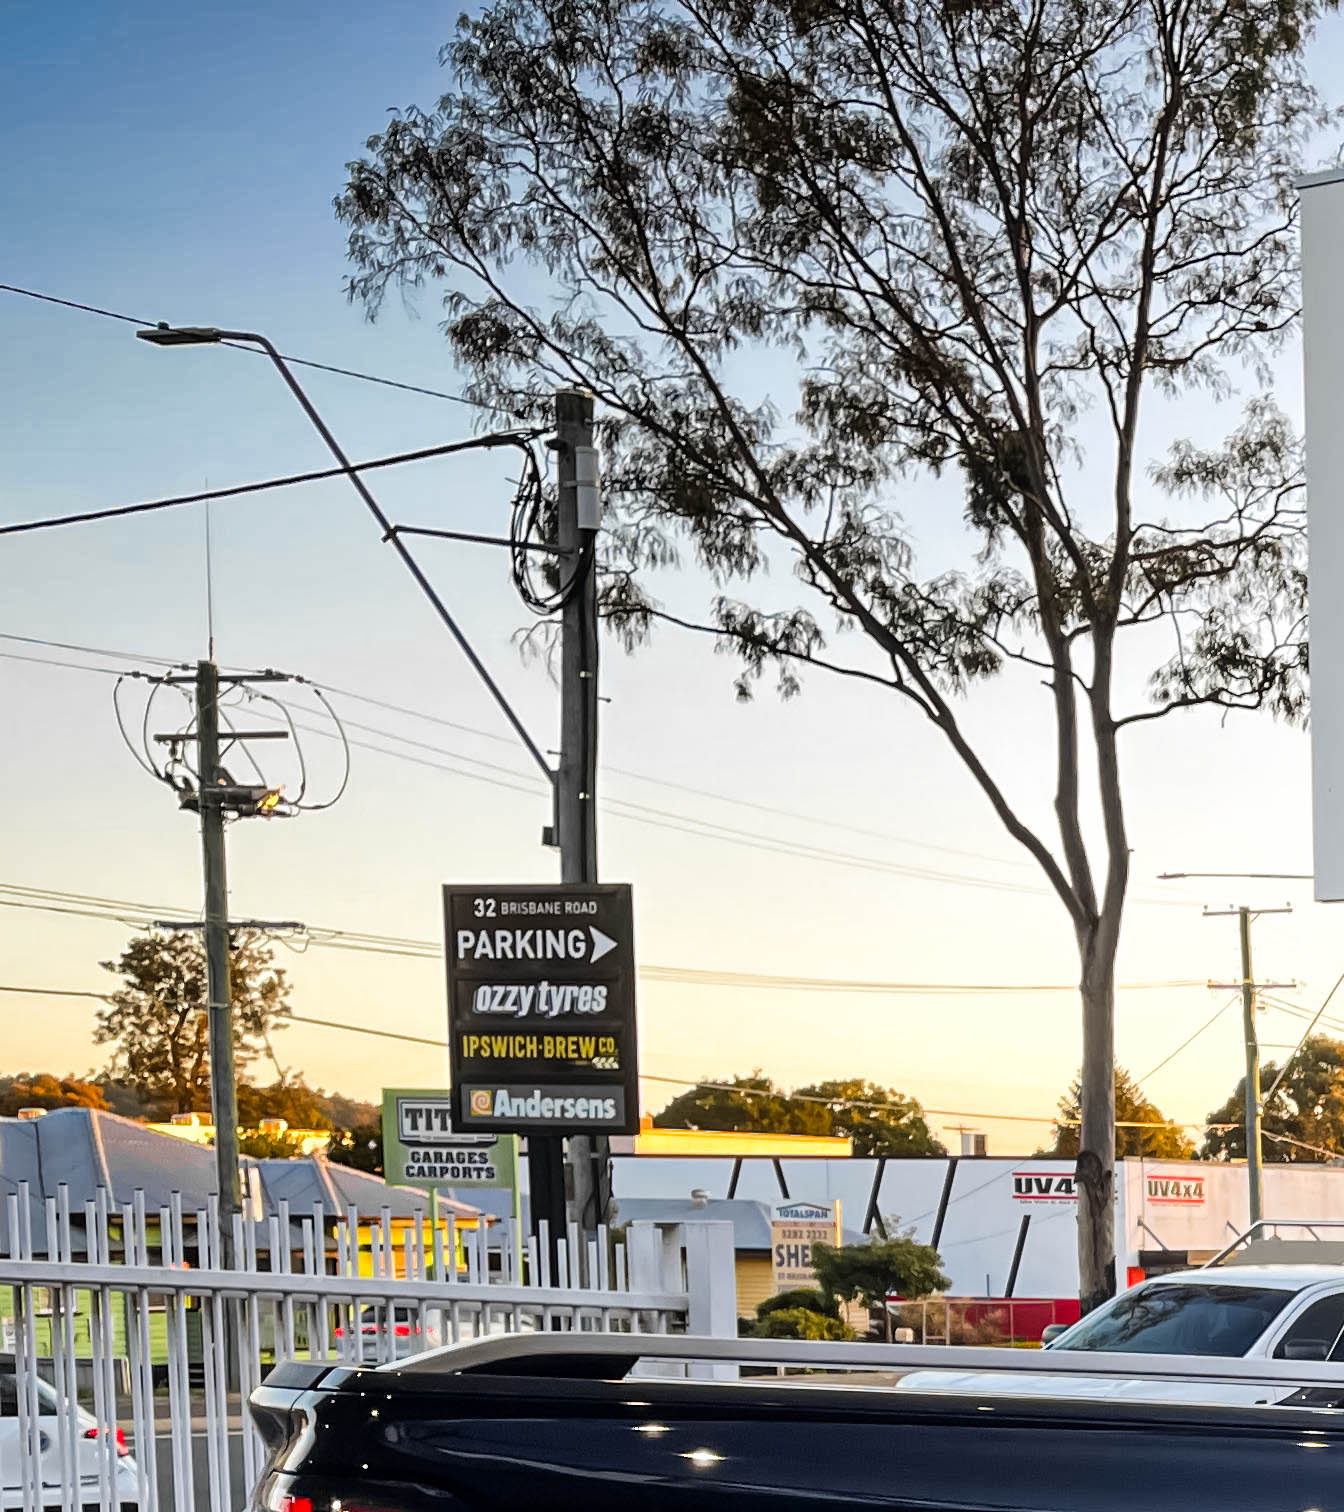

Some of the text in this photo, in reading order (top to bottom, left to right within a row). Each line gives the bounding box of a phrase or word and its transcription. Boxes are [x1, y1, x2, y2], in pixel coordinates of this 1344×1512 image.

[474, 898, 598, 917] 32 BRISBANE ROAD
[457, 929, 587, 959] PARKING
[473, 980, 608, 1018] ozzy tyres
[494, 1089, 616, 1119] Andersens
[410, 1151, 489, 1165] GARAGES
[405, 1165, 496, 1180] CARPORTS
[1148, 1180, 1205, 1199] UV4x4
